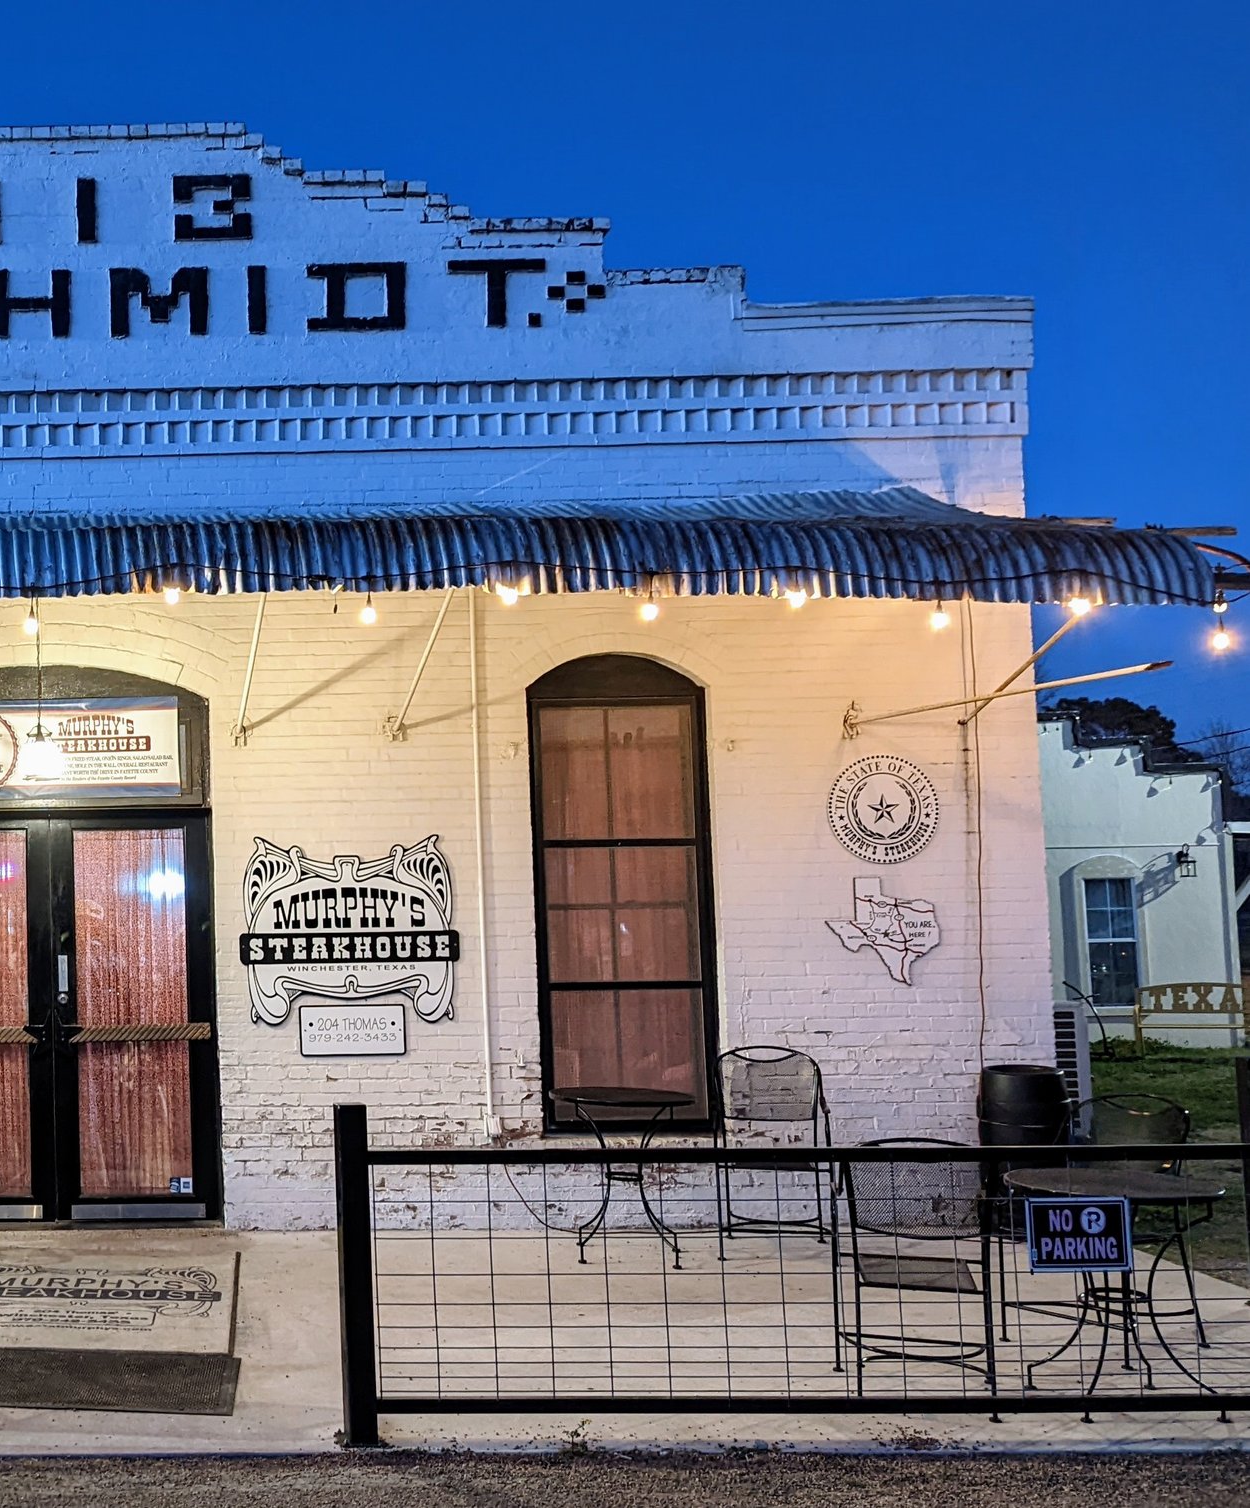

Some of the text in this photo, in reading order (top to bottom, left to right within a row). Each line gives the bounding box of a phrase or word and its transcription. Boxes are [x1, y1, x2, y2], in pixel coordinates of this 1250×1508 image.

[58, 714, 134, 736] MURPHY'S
[56, 738, 147, 752] TEAKHOUSE
[846, 761, 882, 784] STATE
[888, 762, 906, 774] OF
[884, 822, 930, 856] STEAKHOUSE
[273, 887, 426, 930] MURPHY'S
[250, 935, 450, 961] STEAKHOUSE
[286, 964, 416, 973] WINCHESTER, TEXAS
[1150, 985, 1246, 1010] TEXA
[317, 1018, 388, 1031] 204 THOMAS
[308, 1032, 397, 1043] 979-242-3433
[1048, 1209, 1074, 1232] NO
[1040, 1236, 1118, 1260] PARKING
